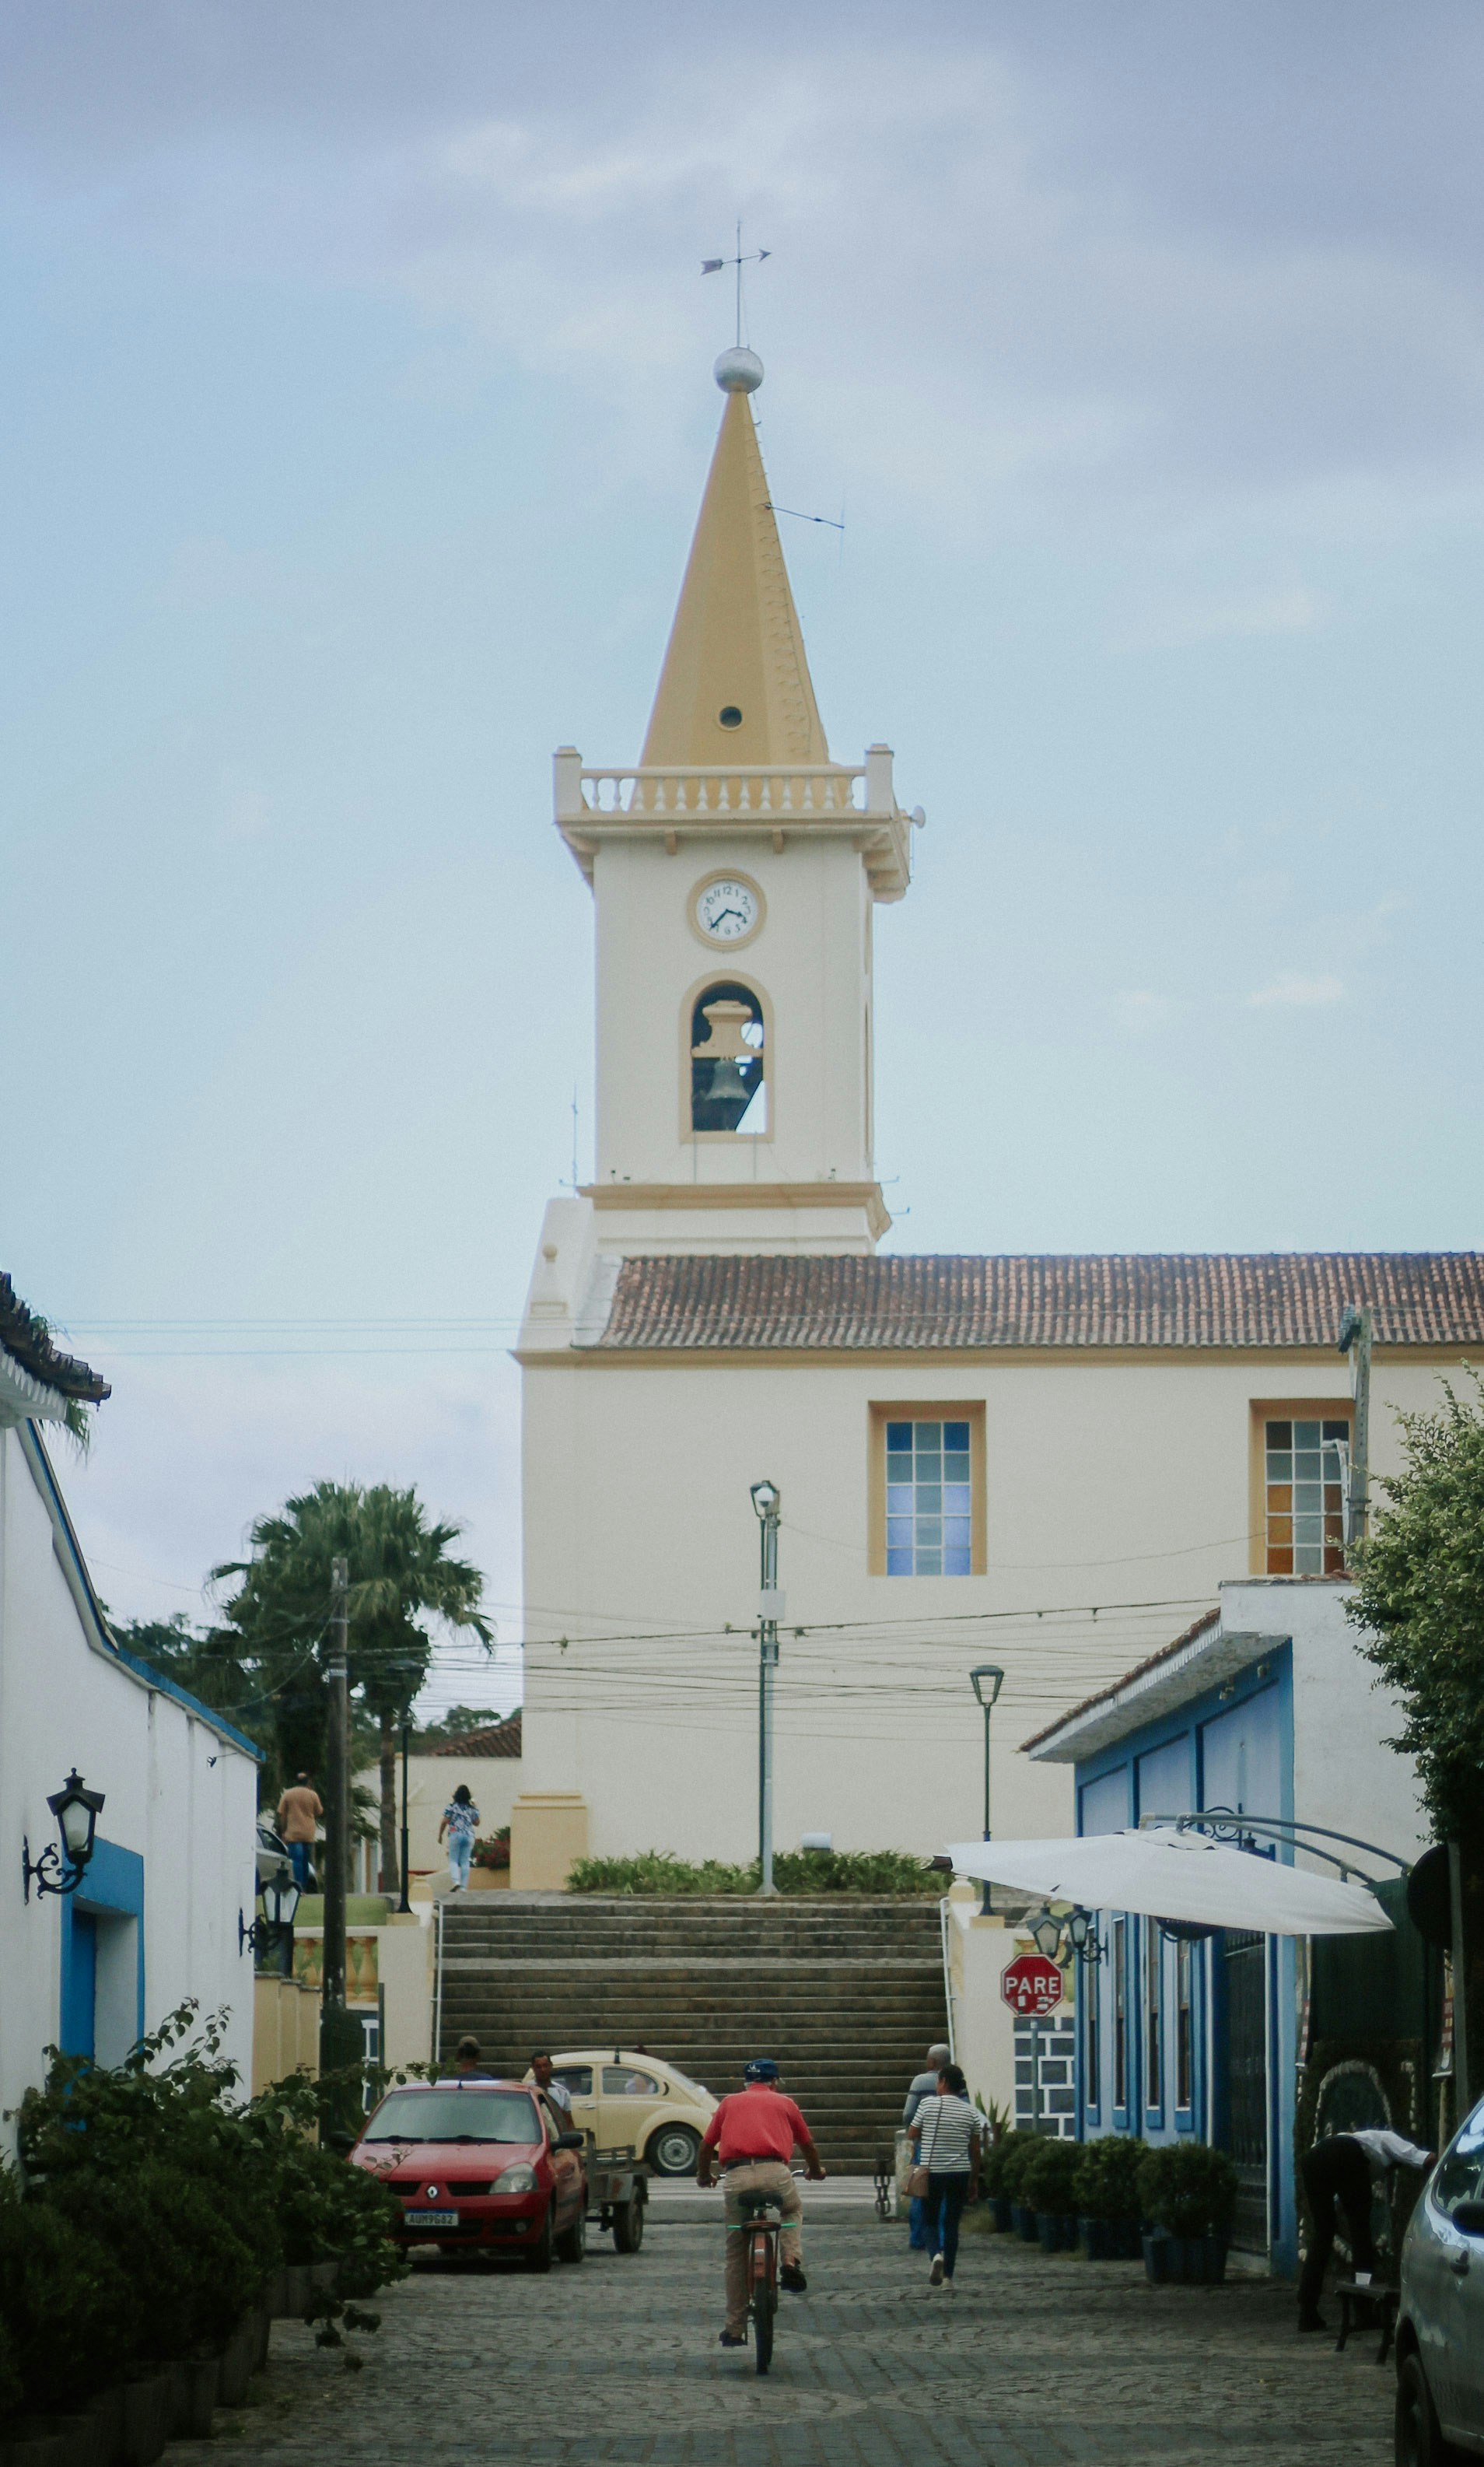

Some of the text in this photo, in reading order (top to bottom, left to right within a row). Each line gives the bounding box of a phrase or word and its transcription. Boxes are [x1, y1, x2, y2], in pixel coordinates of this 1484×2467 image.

[723, 885, 732, 895] 12
[706, 896, 715, 905] 10
[742, 896, 747, 905] 2
[724, 927, 731, 935] 6
[735, 923, 740, 933] 5
[1005, 1977, 1059, 1994] PARE
